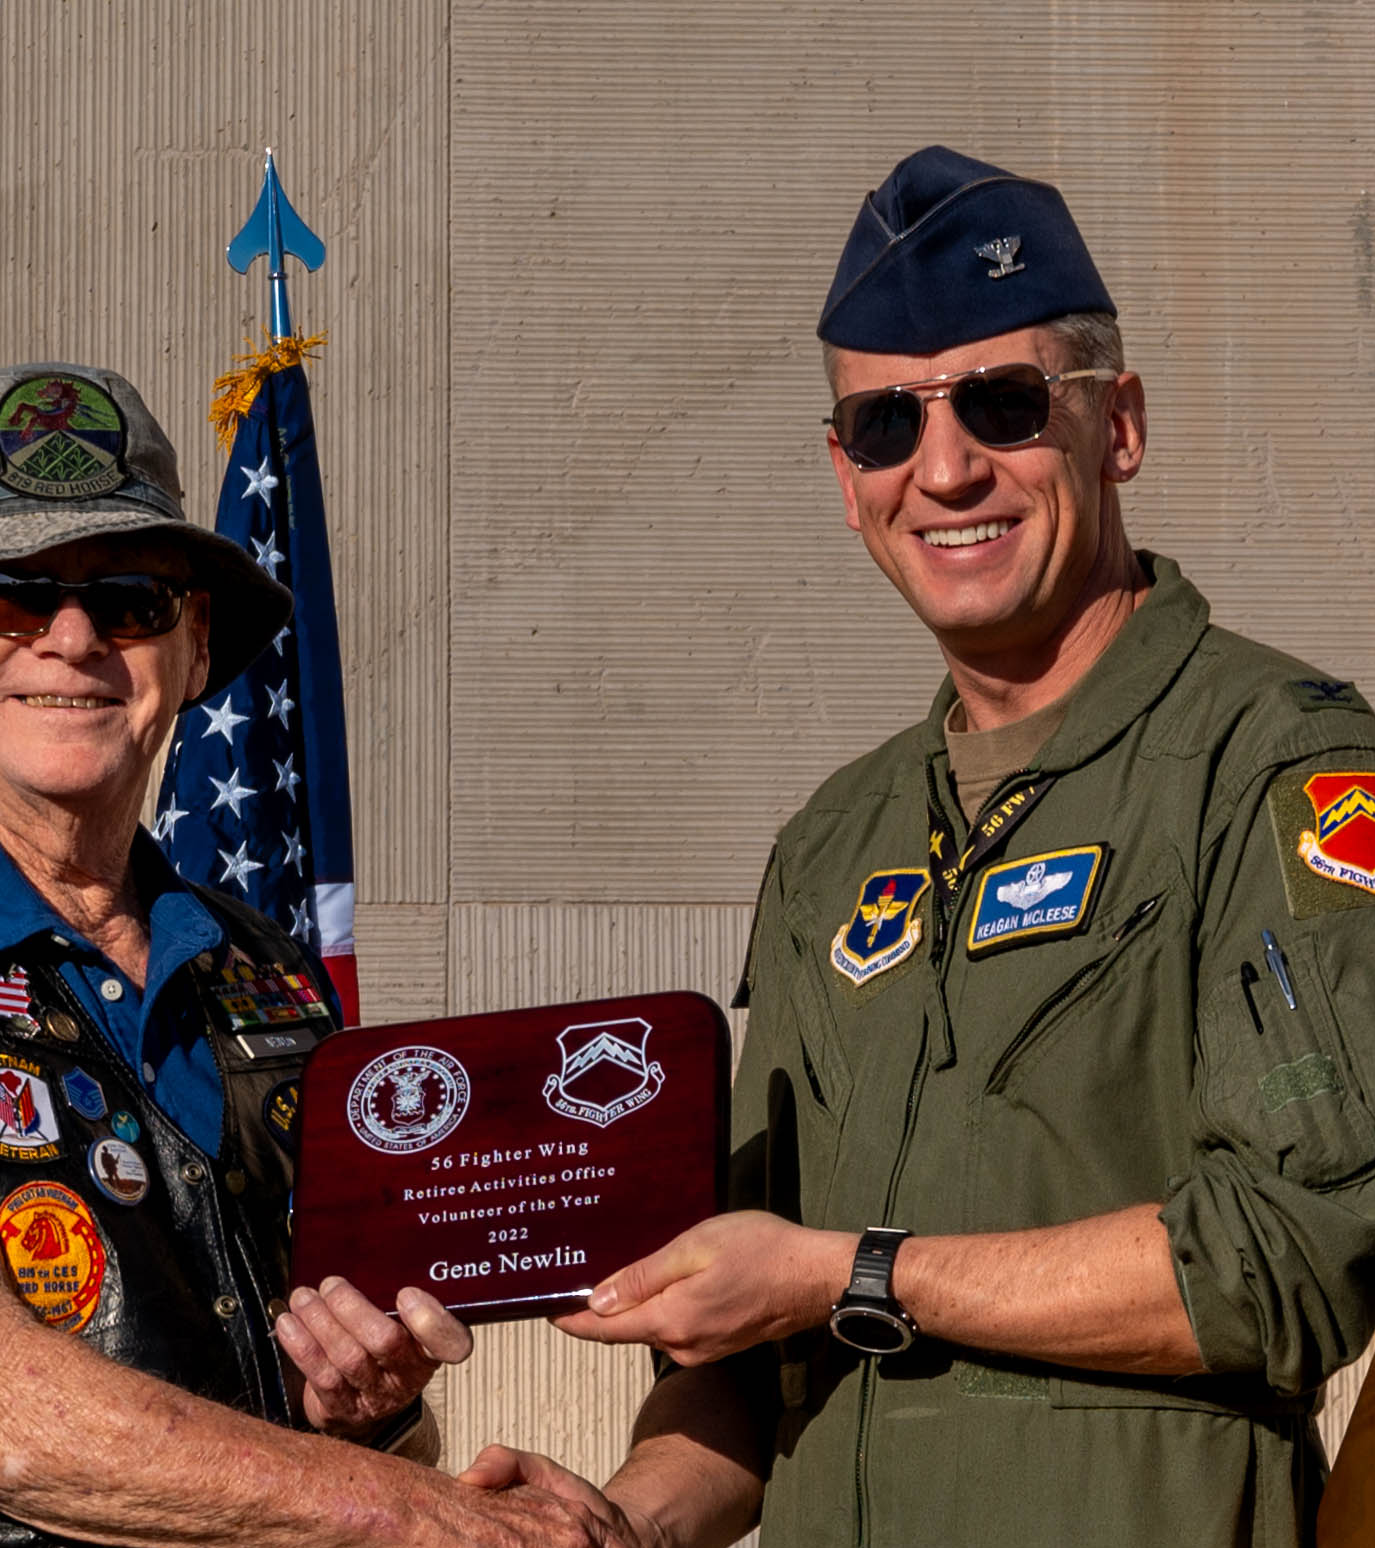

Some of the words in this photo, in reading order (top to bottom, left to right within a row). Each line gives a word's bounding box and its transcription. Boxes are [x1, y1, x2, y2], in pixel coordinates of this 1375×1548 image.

[8, 472, 33, 489] 819
[34, 482, 65, 496] RED
[70, 470, 118, 495] HORSE
[981, 814, 1004, 838] 56
[1000, 791, 1026, 817] FW
[977, 915, 1020, 940] KEAGAN
[1021, 904, 1078, 928] MCLEESE
[351, 1059, 387, 1122] DEPARTMENT
[392, 1051, 407, 1061] OF
[413, 1049, 435, 1060] THE
[438, 1056, 455, 1069] AIR
[452, 1070, 468, 1103] FORCE
[577, 1105, 625, 1123] FIGHTER
[625, 1088, 653, 1109] WING
[383, 1141, 414, 1151] STATES
[431, 1155, 454, 1171] 56
[459, 1149, 533, 1168] Fighter
[538, 1141, 590, 1156] Wing
[403, 1185, 466, 1202] Retiree
[470, 1173, 556, 1193] Activities
[561, 1165, 616, 1183] Office
[418, 1206, 503, 1225] Volunteer
[508, 1201, 527, 1215] of
[530, 1198, 556, 1211] the
[560, 1194, 601, 1208] Year
[487, 1227, 529, 1244] 2022
[429, 1260, 492, 1281] Gene
[498, 1245, 587, 1274] Newlin
[44, 1280, 80, 1293] HORSE
